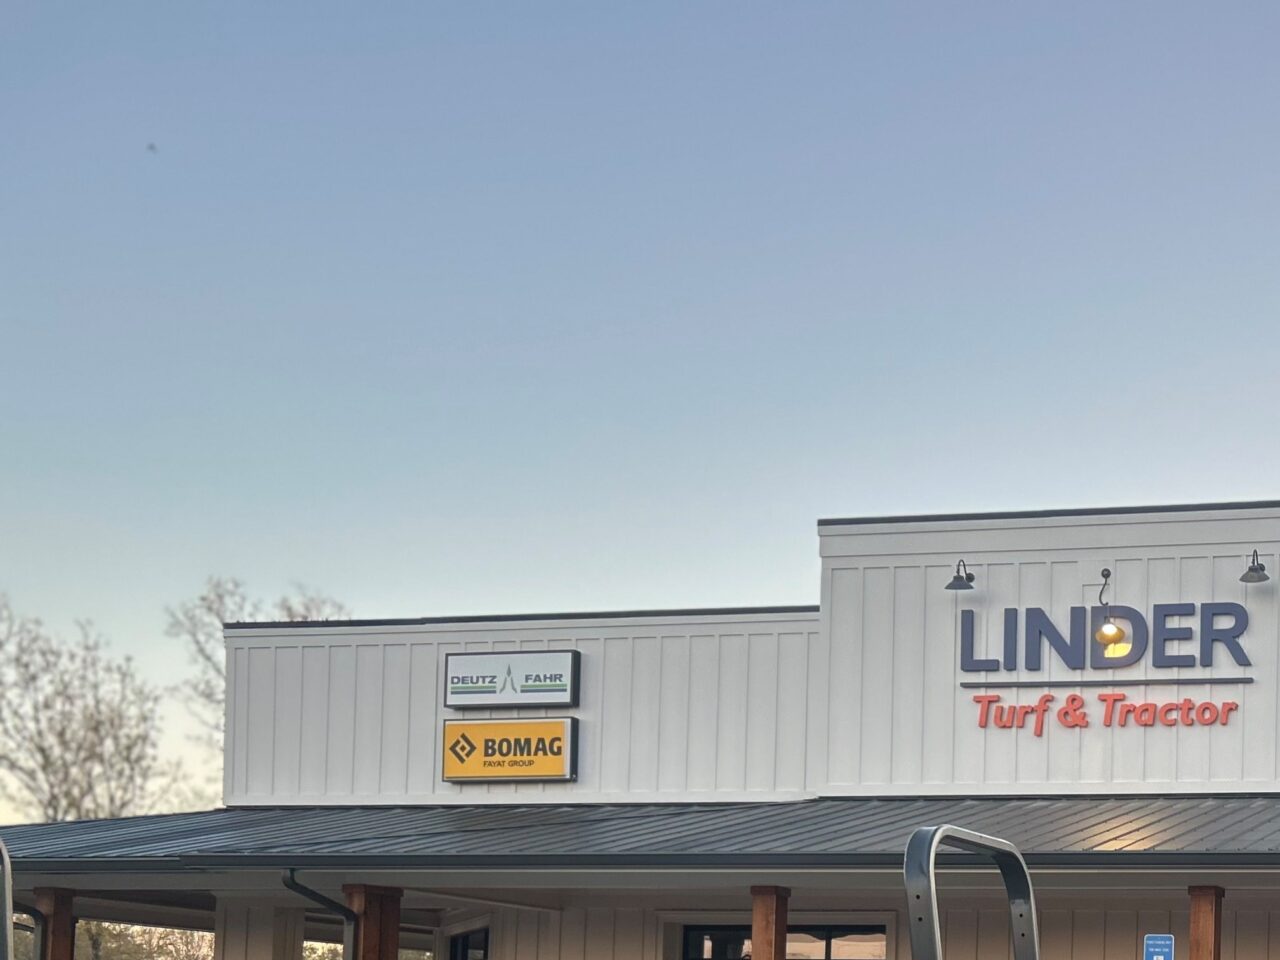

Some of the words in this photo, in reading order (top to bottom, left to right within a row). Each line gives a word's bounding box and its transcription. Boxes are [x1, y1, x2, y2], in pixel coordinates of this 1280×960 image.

[960, 602, 1252, 672] LINDER
[450, 675, 498, 685] DEUTZ
[524, 673, 564, 684] FAHR
[973, 694, 1054, 737] Turf
[1057, 694, 1088, 728] &
[1097, 693, 1239, 727] Tractor
[483, 737, 562, 757] BOMAG
